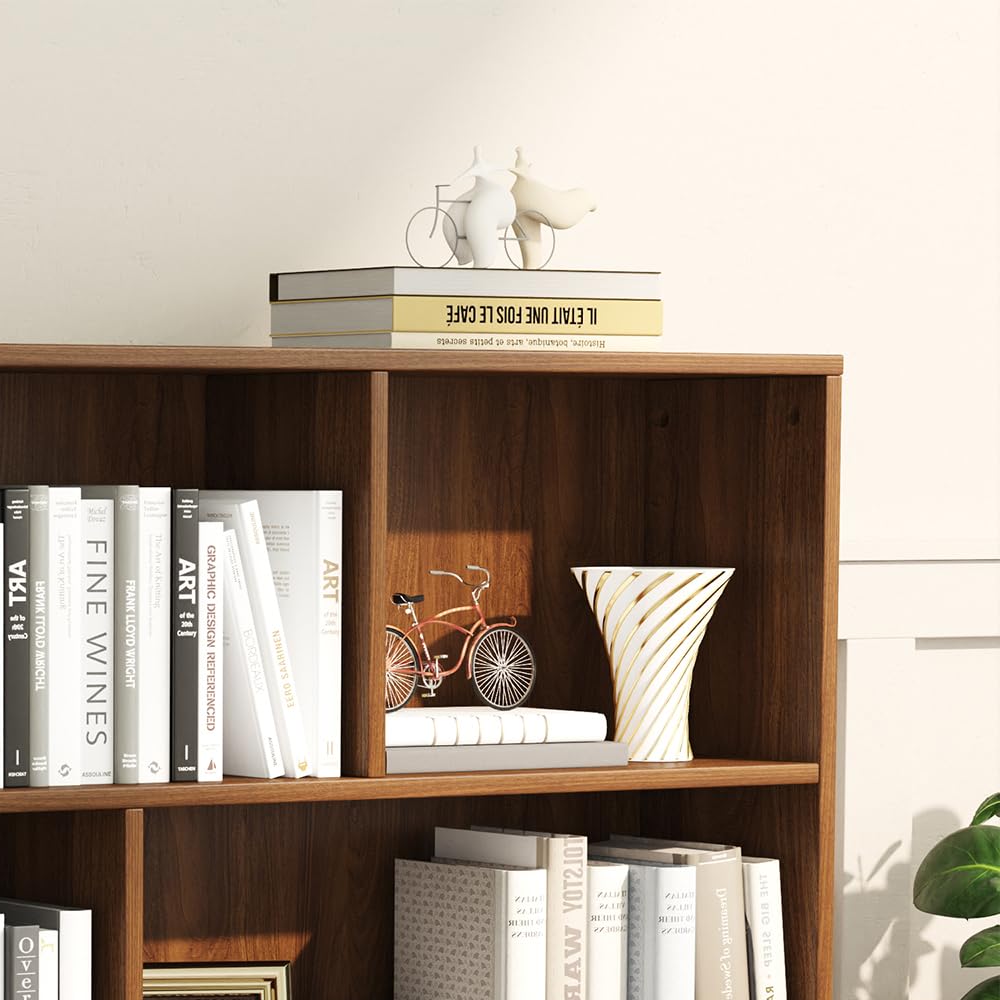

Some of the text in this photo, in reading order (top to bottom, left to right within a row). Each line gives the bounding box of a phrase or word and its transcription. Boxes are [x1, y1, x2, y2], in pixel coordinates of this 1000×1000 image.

[446, 305, 597, 328] IL ÉTAIT UNE FOIS LE CAFÉ
[469, 338, 493, 346] petits
[526, 338, 568, 347] botanique,
[571, 340, 605, 348] Histoire,
[86, 540, 107, 615] FINE
[178, 557, 196, 604] ART
[323, 559, 339, 603] ART
[125, 580, 136, 689] FRANK LLOYD WRIGHT
[177, 629, 197, 638] Century
[206, 545, 216, 731] GRAPHIC DESIGN REFERENCED
[86, 632, 107, 745] WINES
[272, 629, 295, 708] EERO SAARINEN
